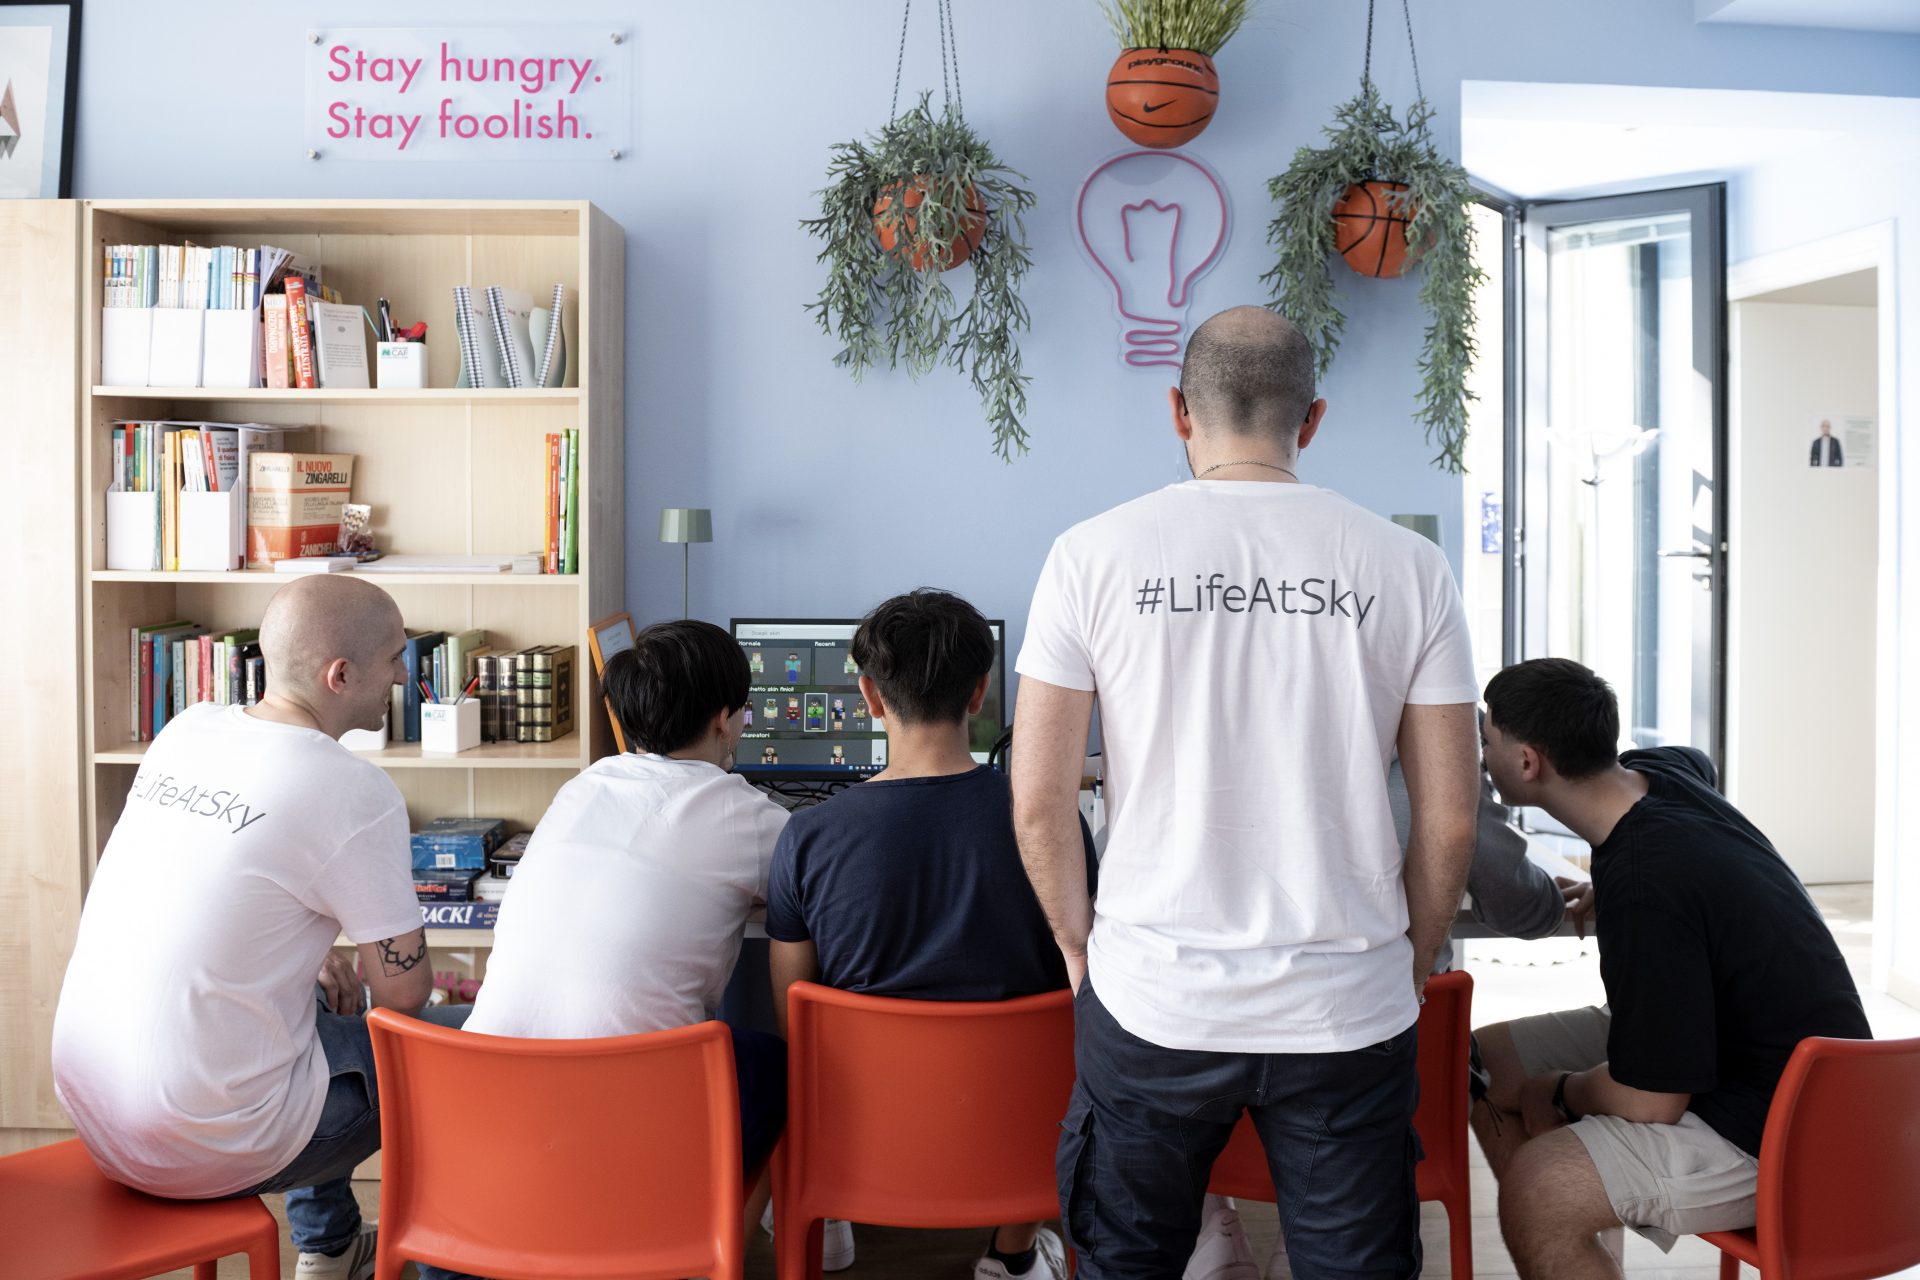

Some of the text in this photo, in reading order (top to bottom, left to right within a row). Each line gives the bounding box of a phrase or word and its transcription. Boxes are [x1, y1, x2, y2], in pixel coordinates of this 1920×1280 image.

[327, 42, 602, 94] Stay hungry.
[326, 98, 593, 150] Stay foolish.
[297, 460, 332, 472] IL NUOVO
[305, 472, 347, 485] ZINGARELLI
[300, 542, 339, 557] ZANICHELL
[1136, 573, 1376, 629] #LifeAtSky
[134, 773, 267, 834] ifeAtSky
